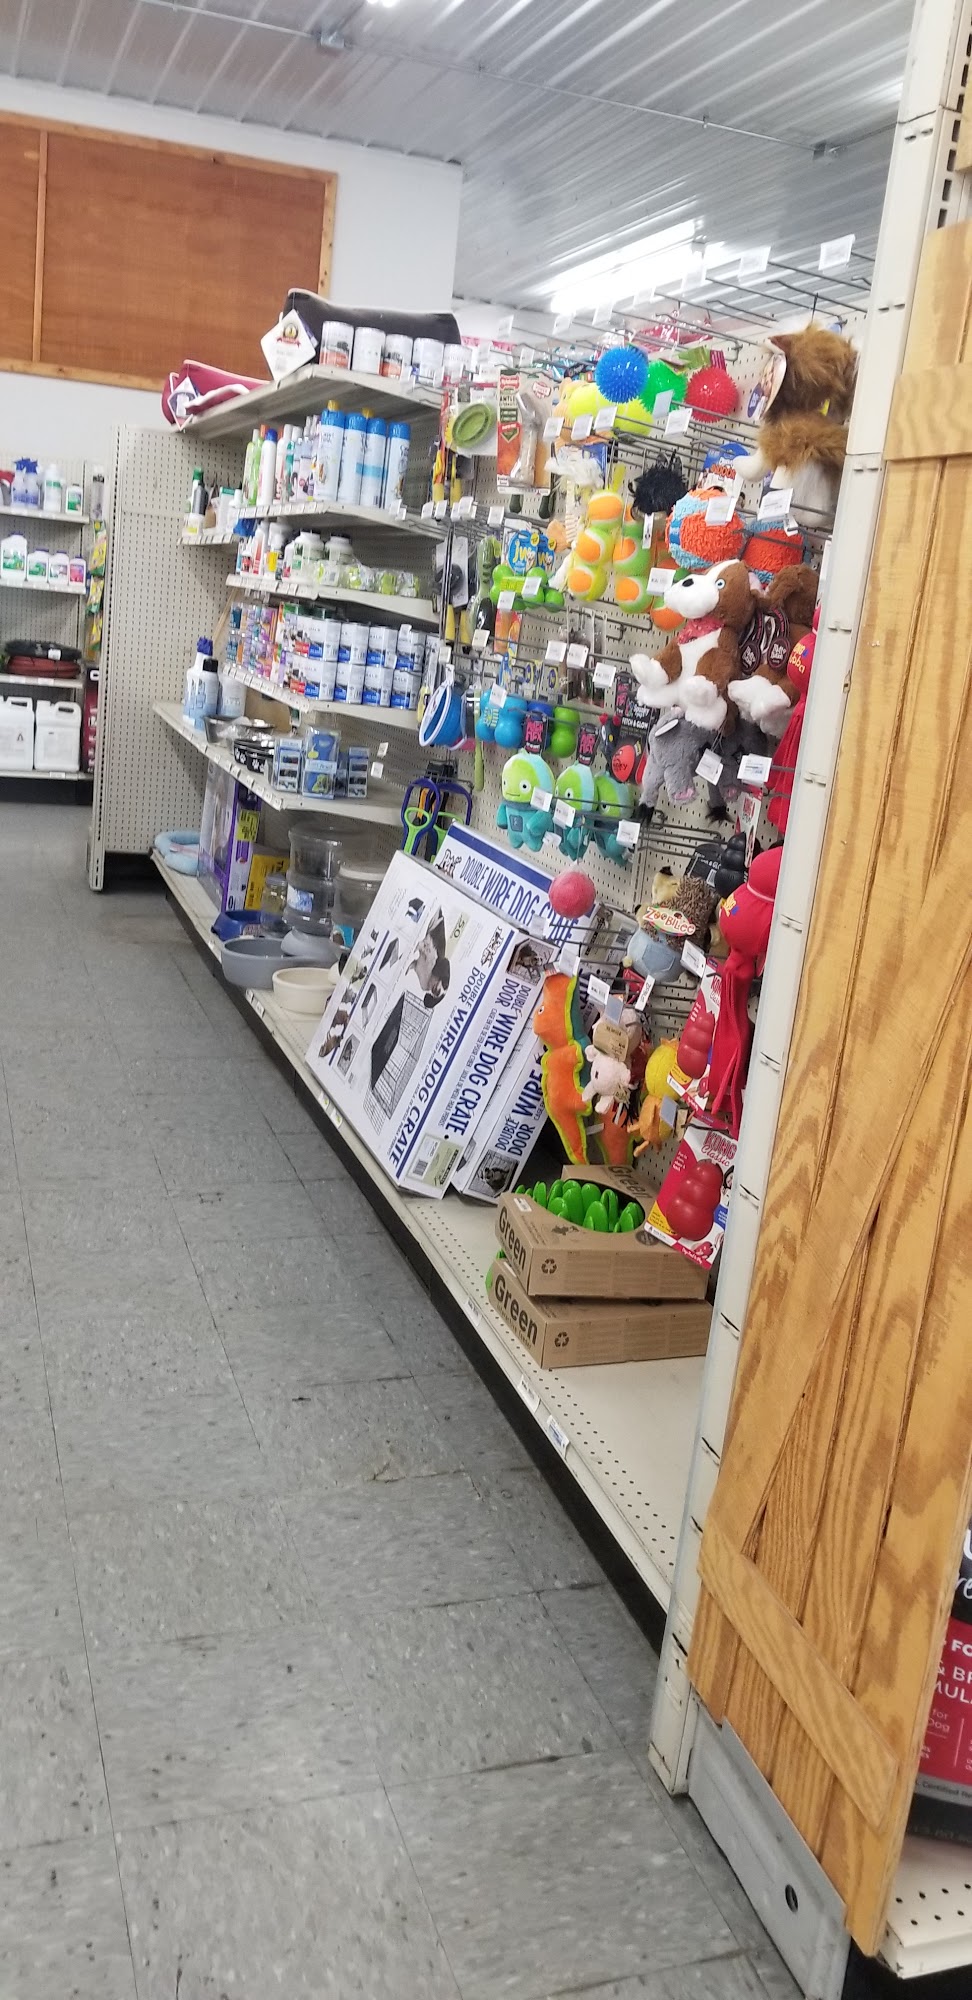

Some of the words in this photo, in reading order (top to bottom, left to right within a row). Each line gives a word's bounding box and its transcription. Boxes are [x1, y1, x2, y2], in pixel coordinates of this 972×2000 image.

[459, 856, 489, 891] DOUBLE
[480, 867, 516, 912] WIRE
[507, 885, 540, 926] DOG
[451, 918, 466, 939] 50
[458, 966, 480, 1004] DOOR
[466, 971, 487, 1010] DOUBLE
[494, 978, 520, 1008] DOOR
[510, 984, 531, 1015] DOUBLE
[443, 1007, 468, 1060] WIRE
[483, 1012, 519, 1053] WIRE
[417, 1061, 443, 1103] DOG
[469, 1050, 499, 1088] DOG
[444, 1087, 482, 1136] CRATE
[511, 1068, 544, 1118] WIRE
[388, 1105, 421, 1168] CRATE
[495, 1115, 521, 1151] DOUBLE
[507, 1123, 536, 1157] DOOR
[702, 1131, 738, 1160] KONG
[701, 1144, 731, 1167] Classic
[609, 1165, 653, 1199] Green
[499, 1206, 526, 1272] Green
[494, 1274, 538, 1346] Green
